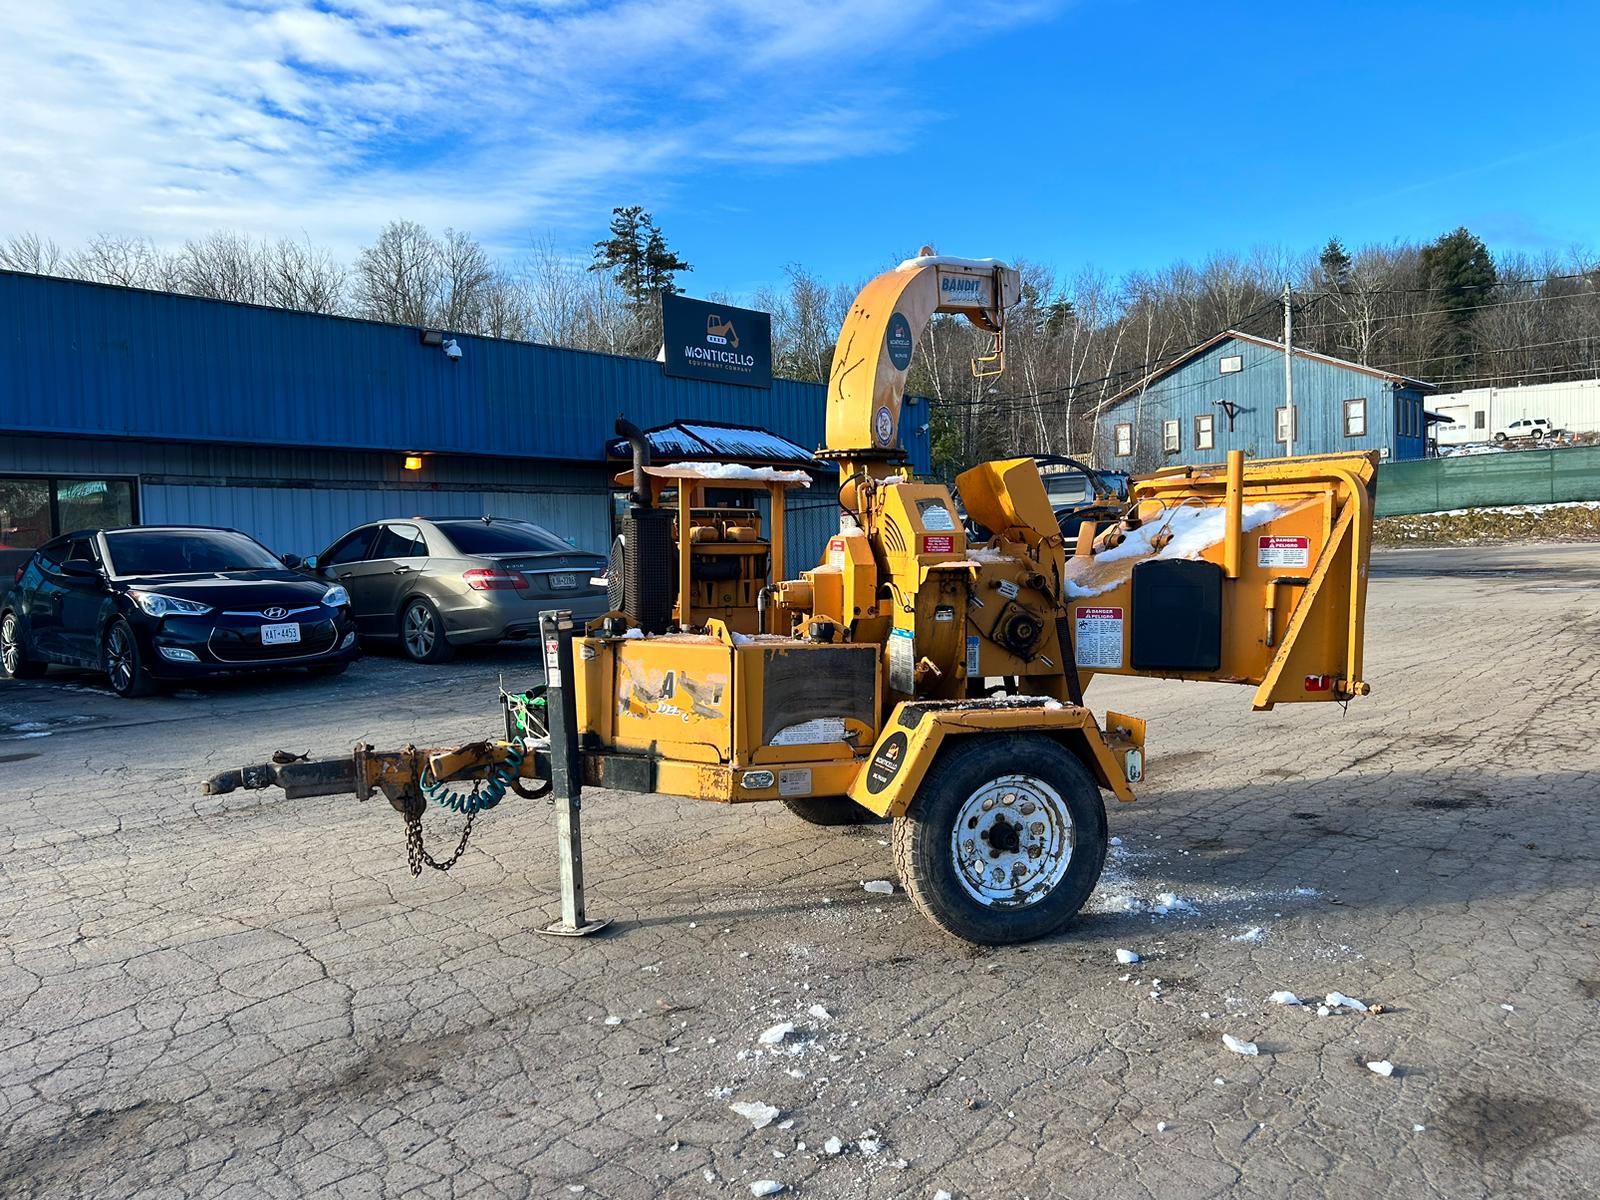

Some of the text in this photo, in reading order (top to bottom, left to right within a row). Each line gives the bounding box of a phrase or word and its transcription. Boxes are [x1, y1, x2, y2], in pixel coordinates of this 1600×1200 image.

[942, 278, 981, 292] BANDIT
[684, 345, 755, 367] MONTICELLO
[688, 360, 752, 373] EQUIPMENT COMPANY
